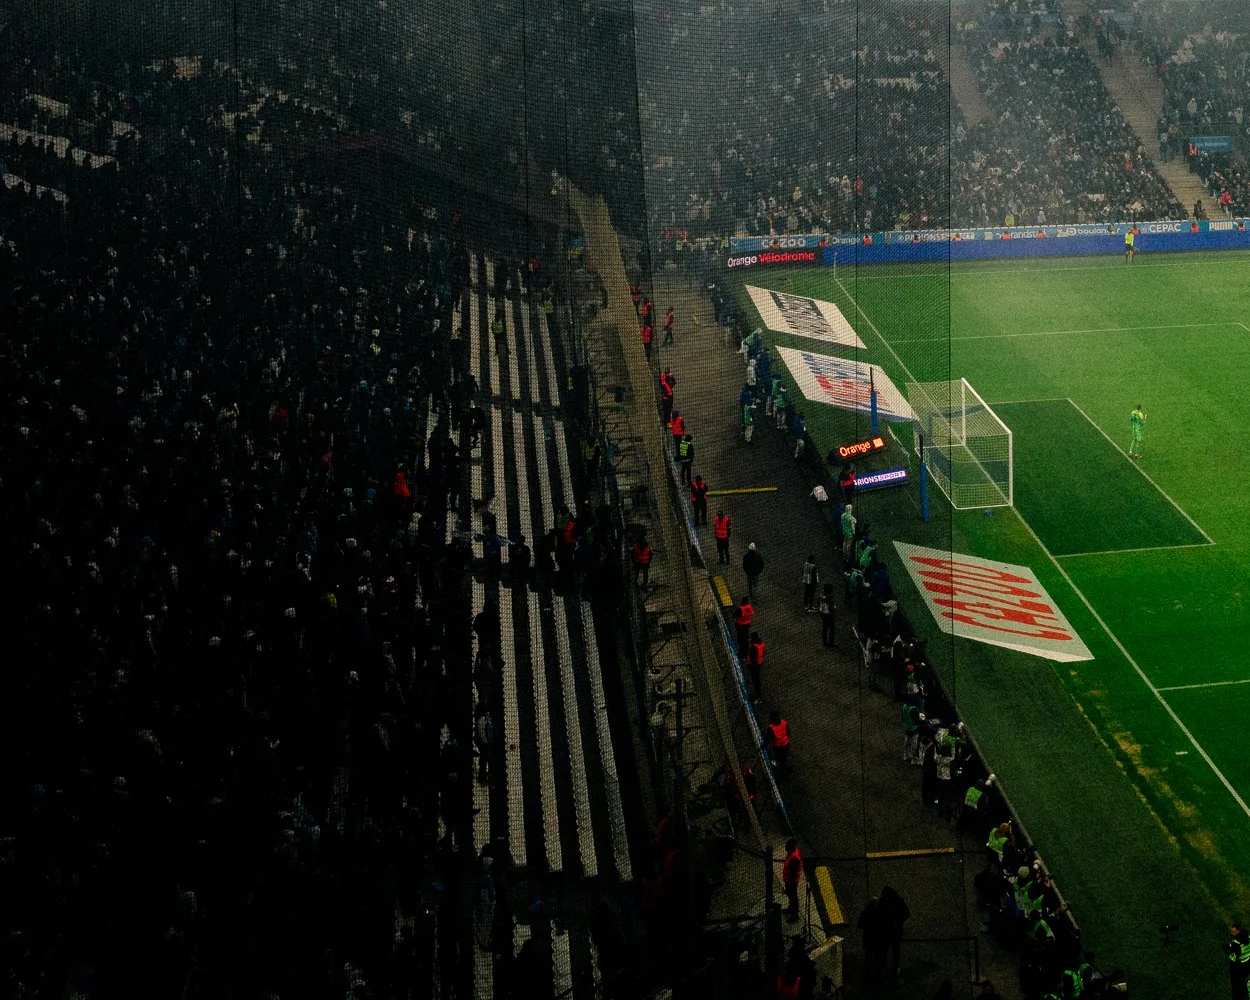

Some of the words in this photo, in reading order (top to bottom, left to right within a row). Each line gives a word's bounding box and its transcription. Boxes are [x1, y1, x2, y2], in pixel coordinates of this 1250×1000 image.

[1011, 228, 1046, 239] randst
[1078, 227, 1120, 235] boulanr
[1149, 223, 1181, 233] CEPAC
[727, 255, 757, 268] Orange
[758, 251, 815, 263] Vélodrome
[839, 440, 871, 457] Orange
[908, 556, 1073, 641] CAZOO
